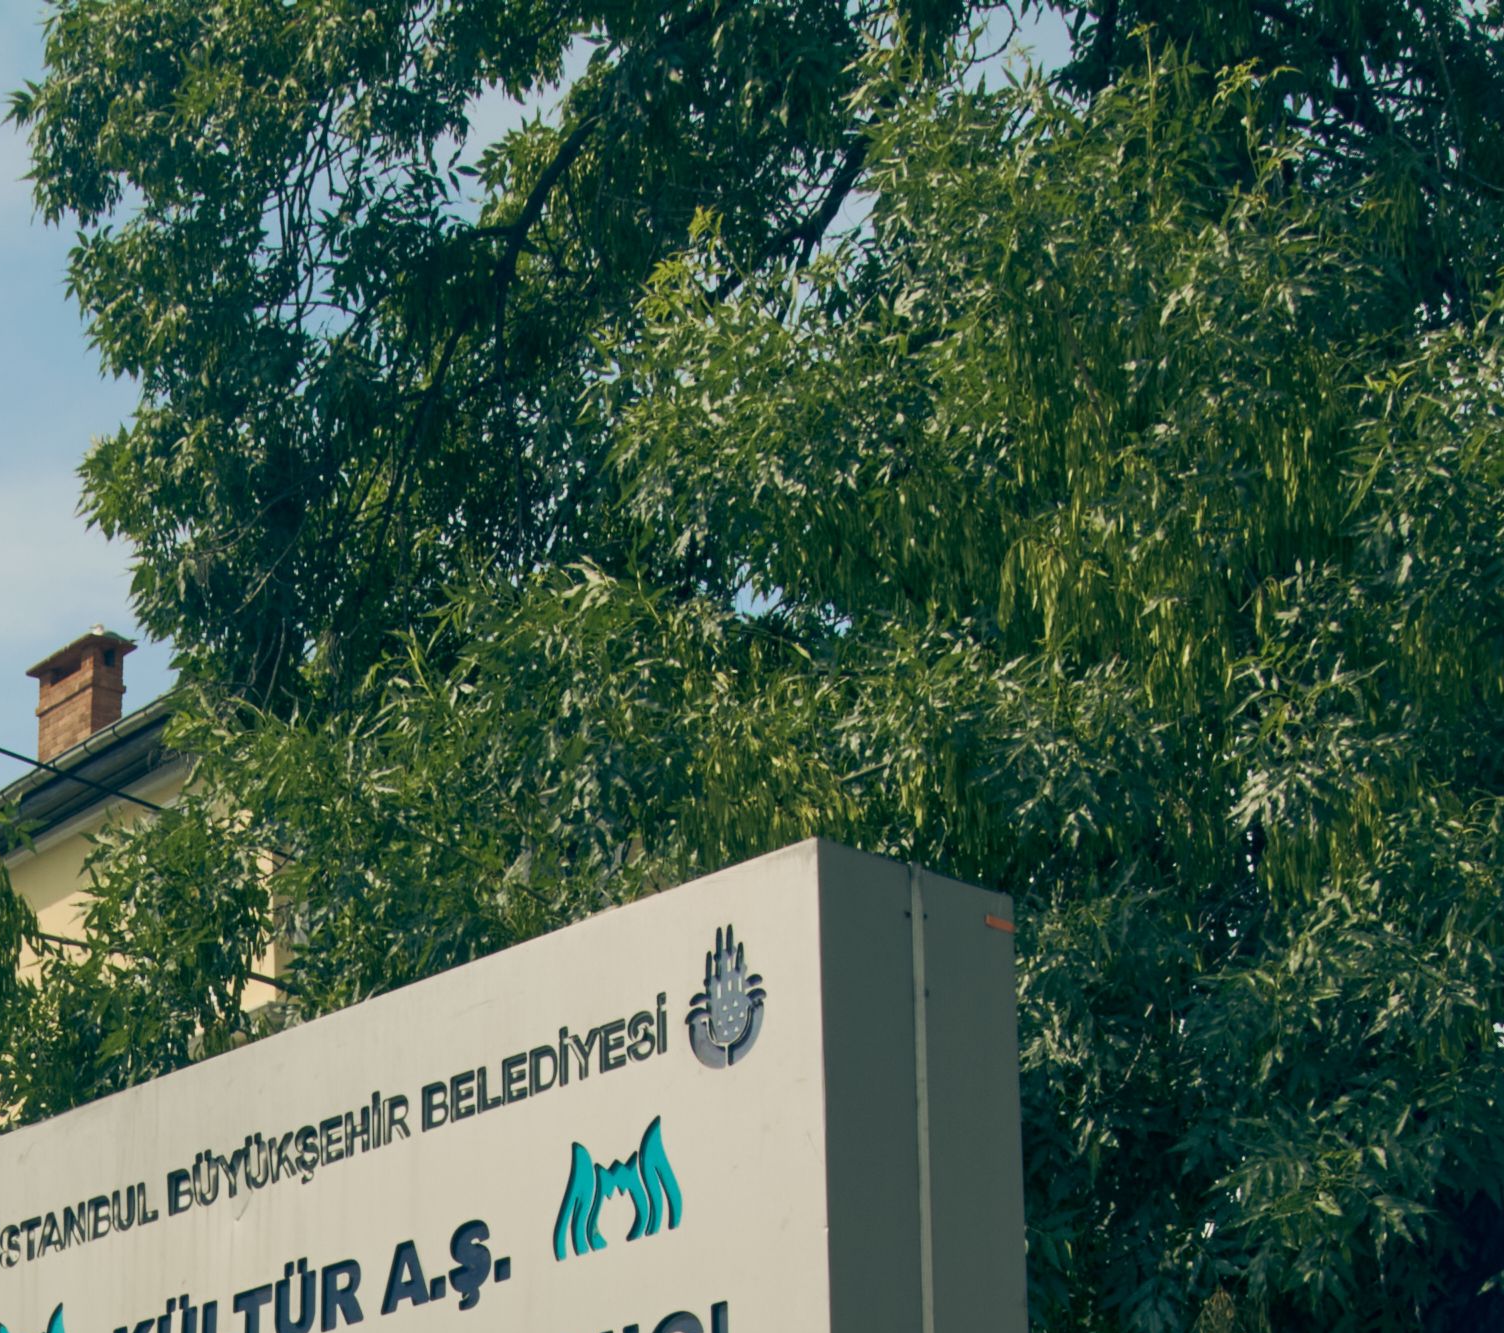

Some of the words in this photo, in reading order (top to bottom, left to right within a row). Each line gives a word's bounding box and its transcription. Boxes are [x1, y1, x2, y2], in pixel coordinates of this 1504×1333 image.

[167, 1090, 411, 1216] BÜYÜKŞEHİR
[421, 991, 668, 1132] BELEDİYESİ
[381, 1219, 511, 1314] A.Ş.
